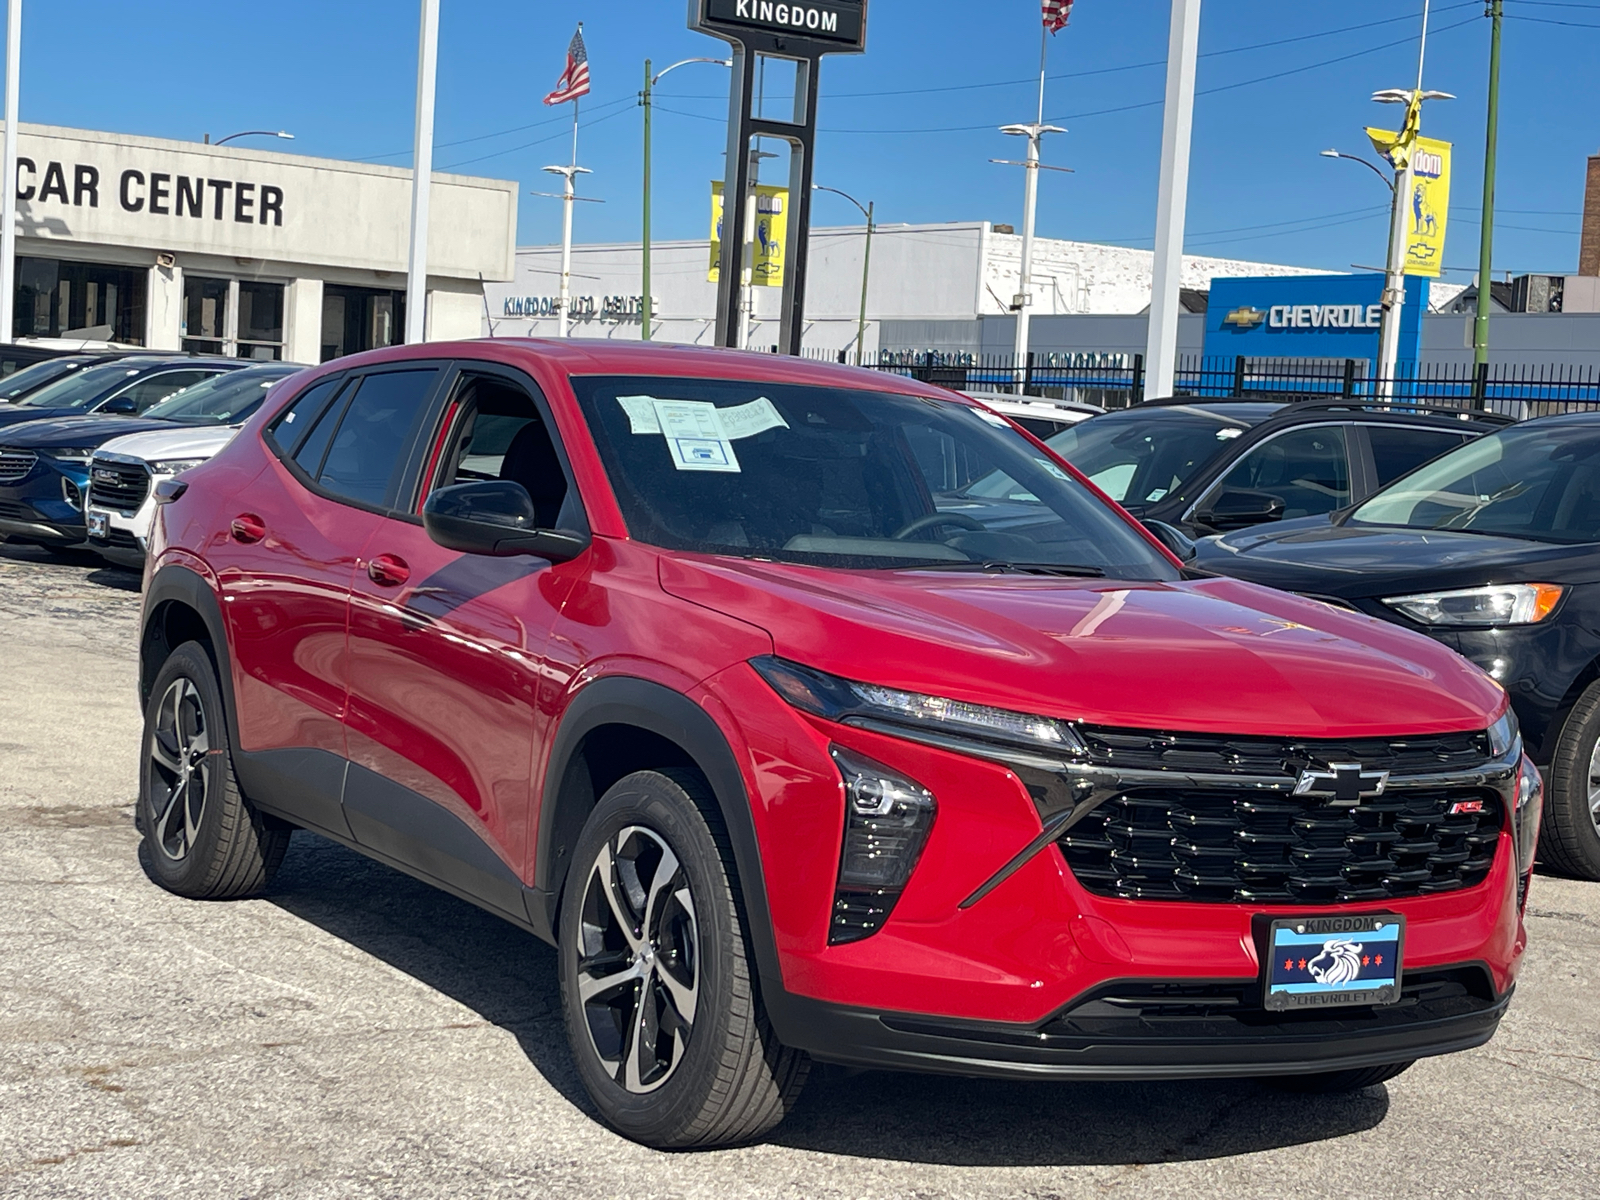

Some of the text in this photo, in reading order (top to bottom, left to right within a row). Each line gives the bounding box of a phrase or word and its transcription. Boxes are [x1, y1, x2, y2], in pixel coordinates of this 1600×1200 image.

[735, 0, 838, 33] KINGDOM
[1413, 148, 1442, 179] dom
[15, 157, 285, 227] CAR CENTER
[758, 194, 783, 214] dom
[567, 295, 594, 315] UTO
[602, 295, 653, 315] CENTE
[1269, 304, 1382, 329] CHEVROLE
[1449, 799, 1484, 815] RS
[1305, 917, 1375, 933] KINGDOM
[1296, 991, 1369, 1006] CHEVROLET
